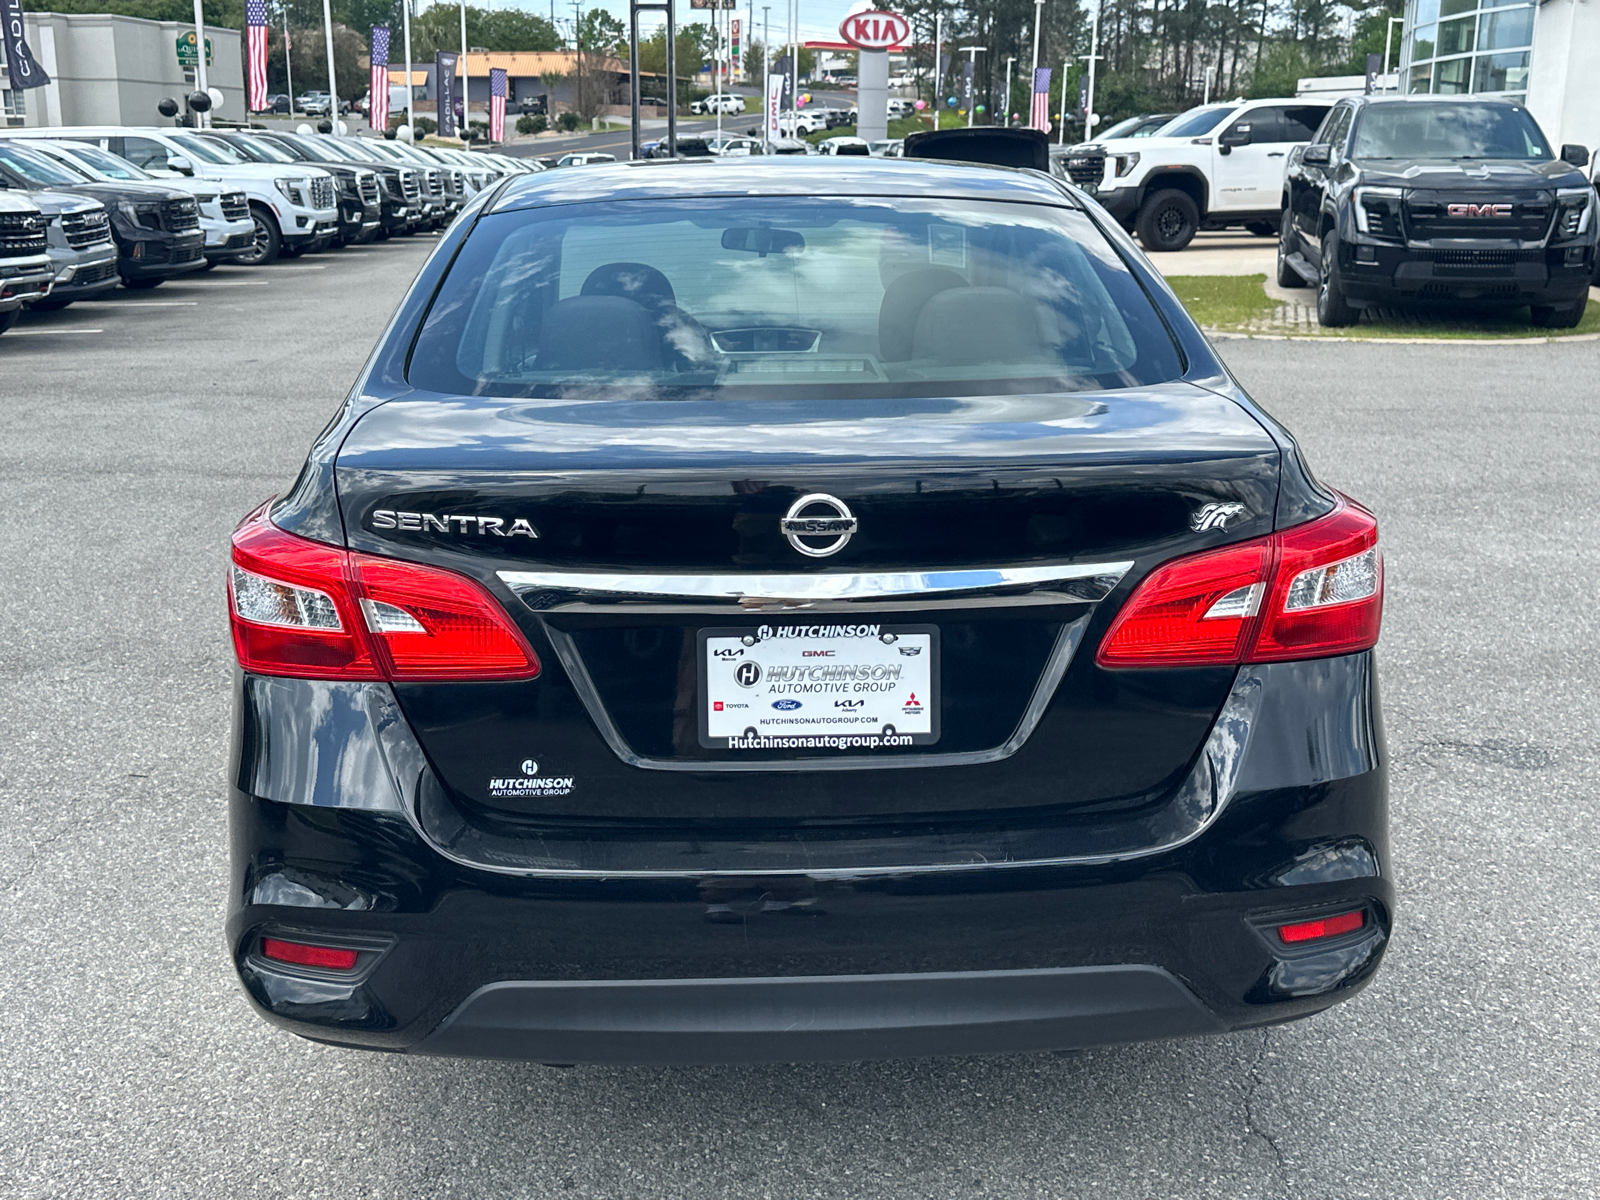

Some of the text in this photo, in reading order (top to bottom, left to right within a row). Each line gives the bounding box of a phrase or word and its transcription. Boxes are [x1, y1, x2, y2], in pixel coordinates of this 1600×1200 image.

[854, 19, 898, 41] KIA
[442, 69, 452, 133] CADILLAC
[771, 88, 779, 131] GMC
[1447, 203, 1513, 217] GMC
[372, 509, 539, 539] SENTRA
[788, 520, 850, 532] NISSAN
[776, 625, 880, 639] HUTCHINSON
[766, 664, 902, 682] HUTCHINSON
[768, 682, 896, 694] AUTOMOTIVE GROUP
[777, 700, 797, 709] Ford
[760, 717, 878, 725] HUTCHINSONAUTOGROUP.COM
[728, 735, 913, 750] Hutchinsonautogroup.com
[489, 778, 573, 789] HUTCHINSON
